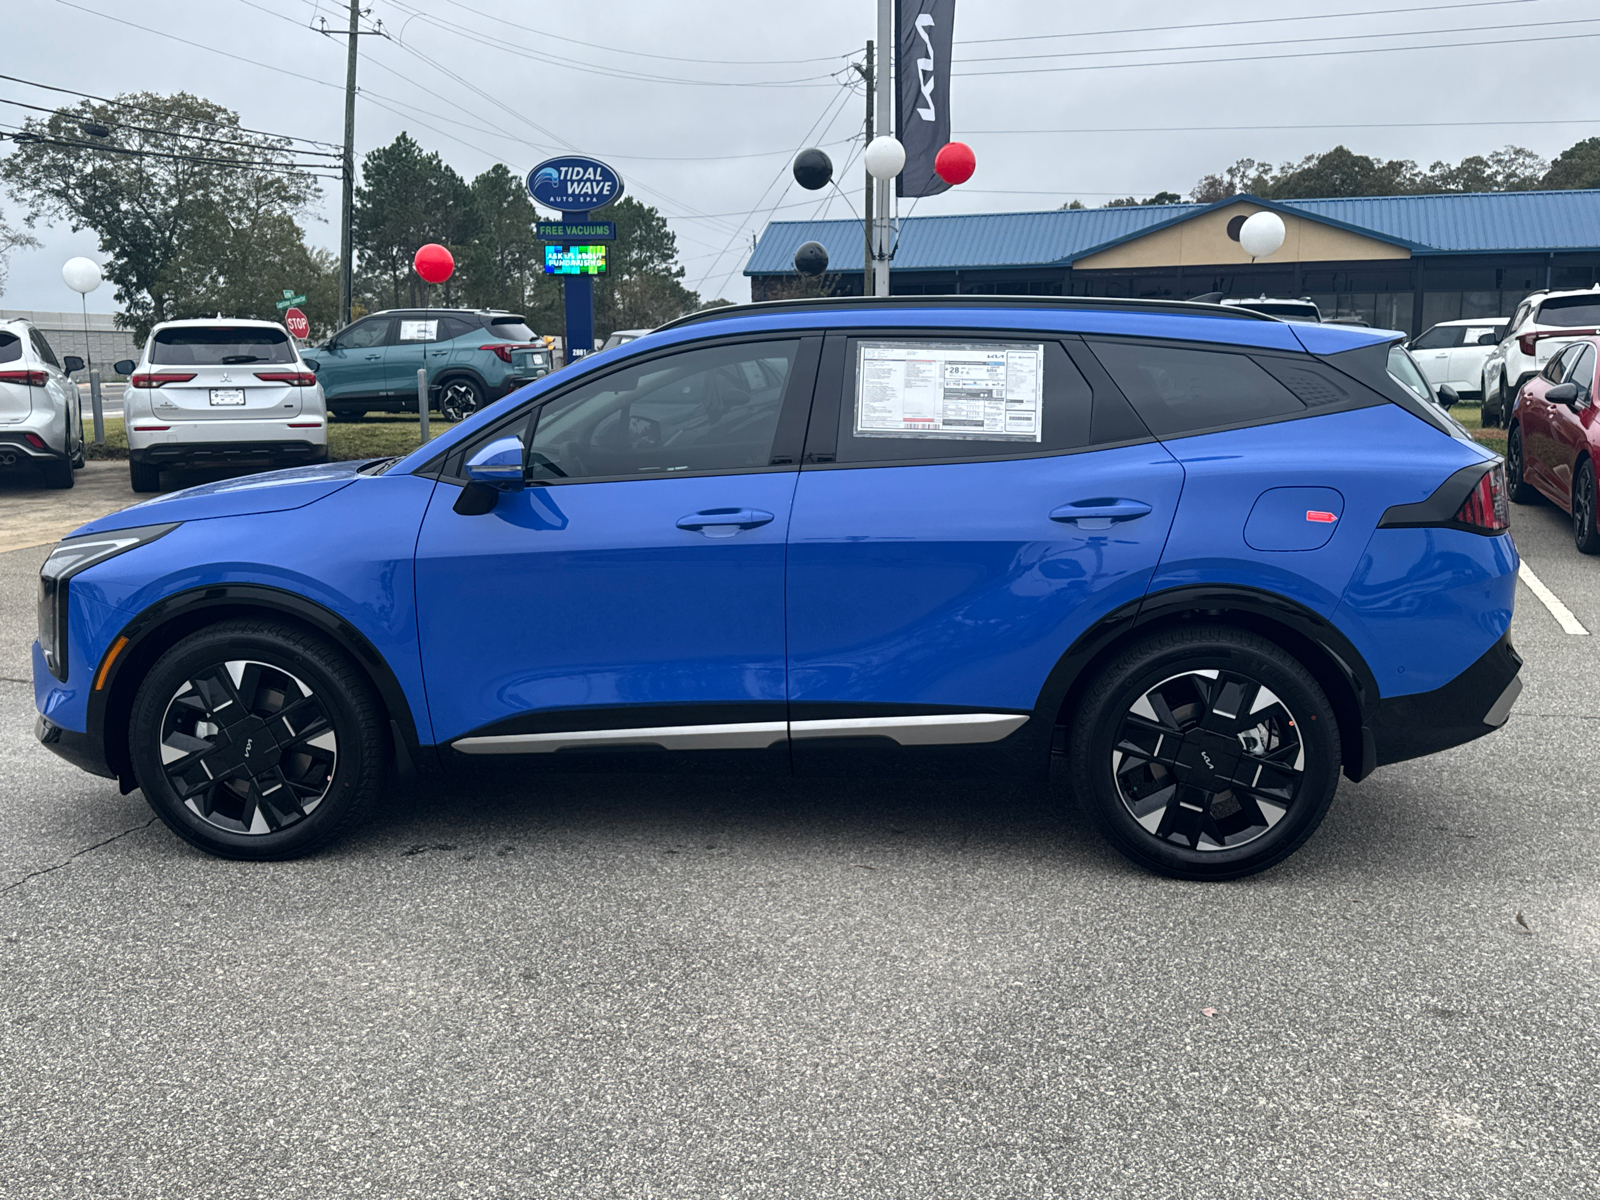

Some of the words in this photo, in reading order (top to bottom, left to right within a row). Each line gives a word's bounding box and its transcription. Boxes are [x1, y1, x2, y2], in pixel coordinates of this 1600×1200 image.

[560, 167, 603, 180] TIDAL
[567, 181, 612, 195] WAVE
[540, 226, 564, 235] FREE
[566, 226, 609, 235] VACUUMS
[548, 252, 563, 260] ASK
[564, 252, 576, 260] US
[577, 252, 602, 260] ABOUT
[548, 259, 602, 267] FUNDRAISING
[287, 317, 307, 330] STOP
[949, 366, 960, 374] 28
